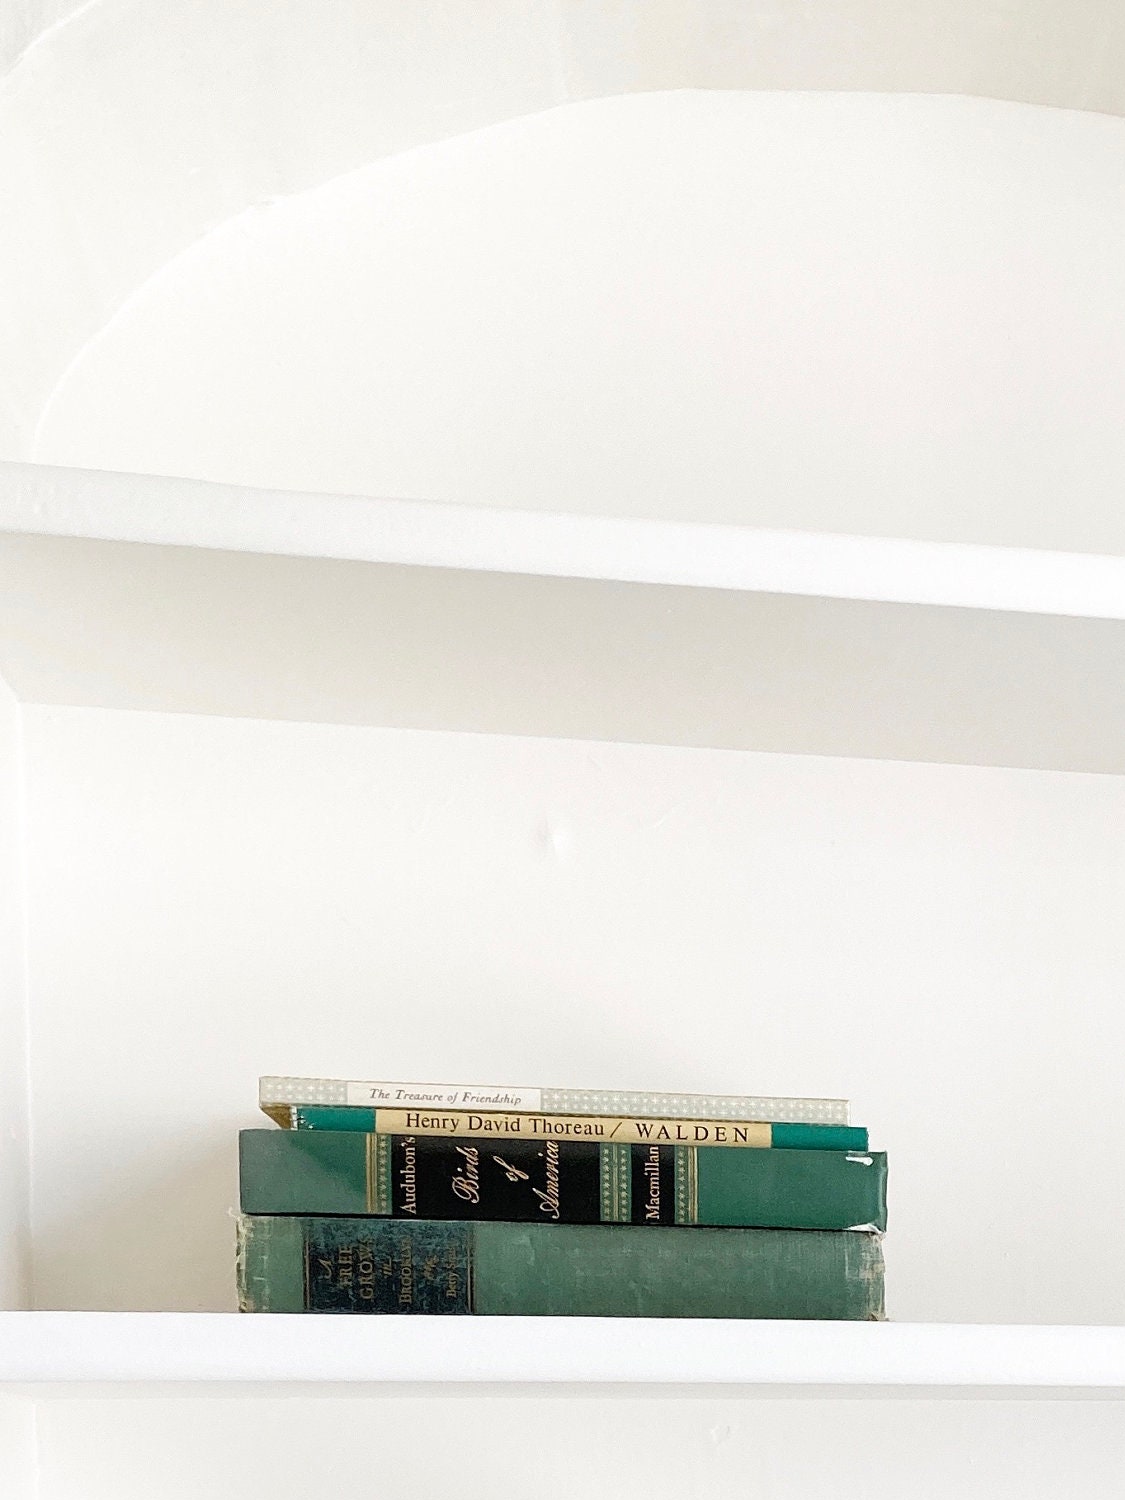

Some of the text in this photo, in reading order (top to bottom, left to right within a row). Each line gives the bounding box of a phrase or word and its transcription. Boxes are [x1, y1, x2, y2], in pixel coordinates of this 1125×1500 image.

[370, 1088, 522, 1107] The Treasure of Friendship
[406, 1112, 749, 1143] Henry David Thoreau WALDEN
[399, 1136, 417, 1215] Audubon's
[452, 1140, 561, 1219] Birds of America
[645, 1145, 660, 1220] Macmillan
